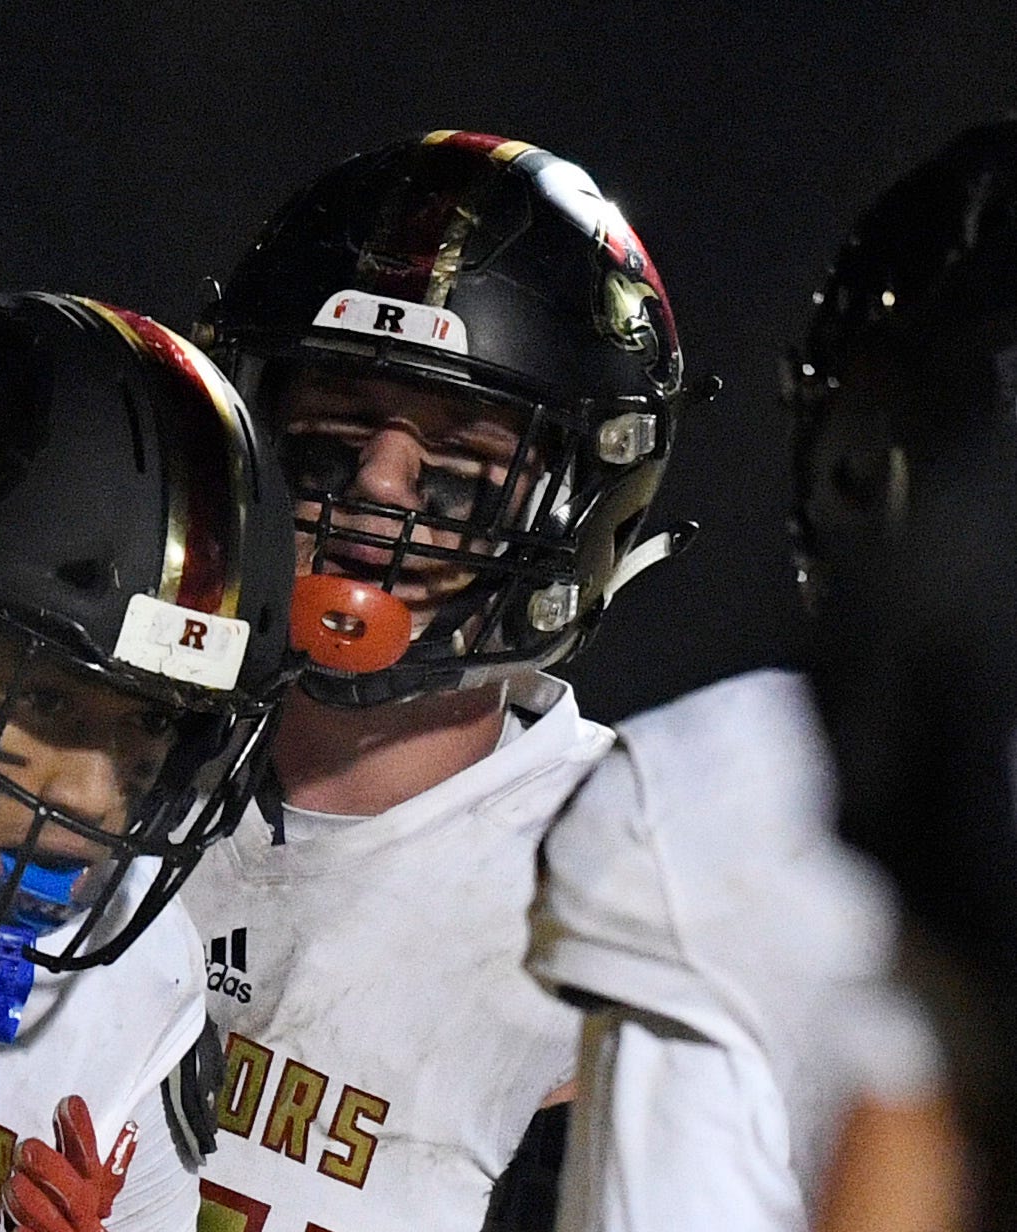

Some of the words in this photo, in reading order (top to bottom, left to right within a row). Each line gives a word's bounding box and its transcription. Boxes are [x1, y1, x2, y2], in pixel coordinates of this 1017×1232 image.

[373, 303, 405, 334] R
[179, 617, 208, 652] R
[206, 962, 253, 1004] das
